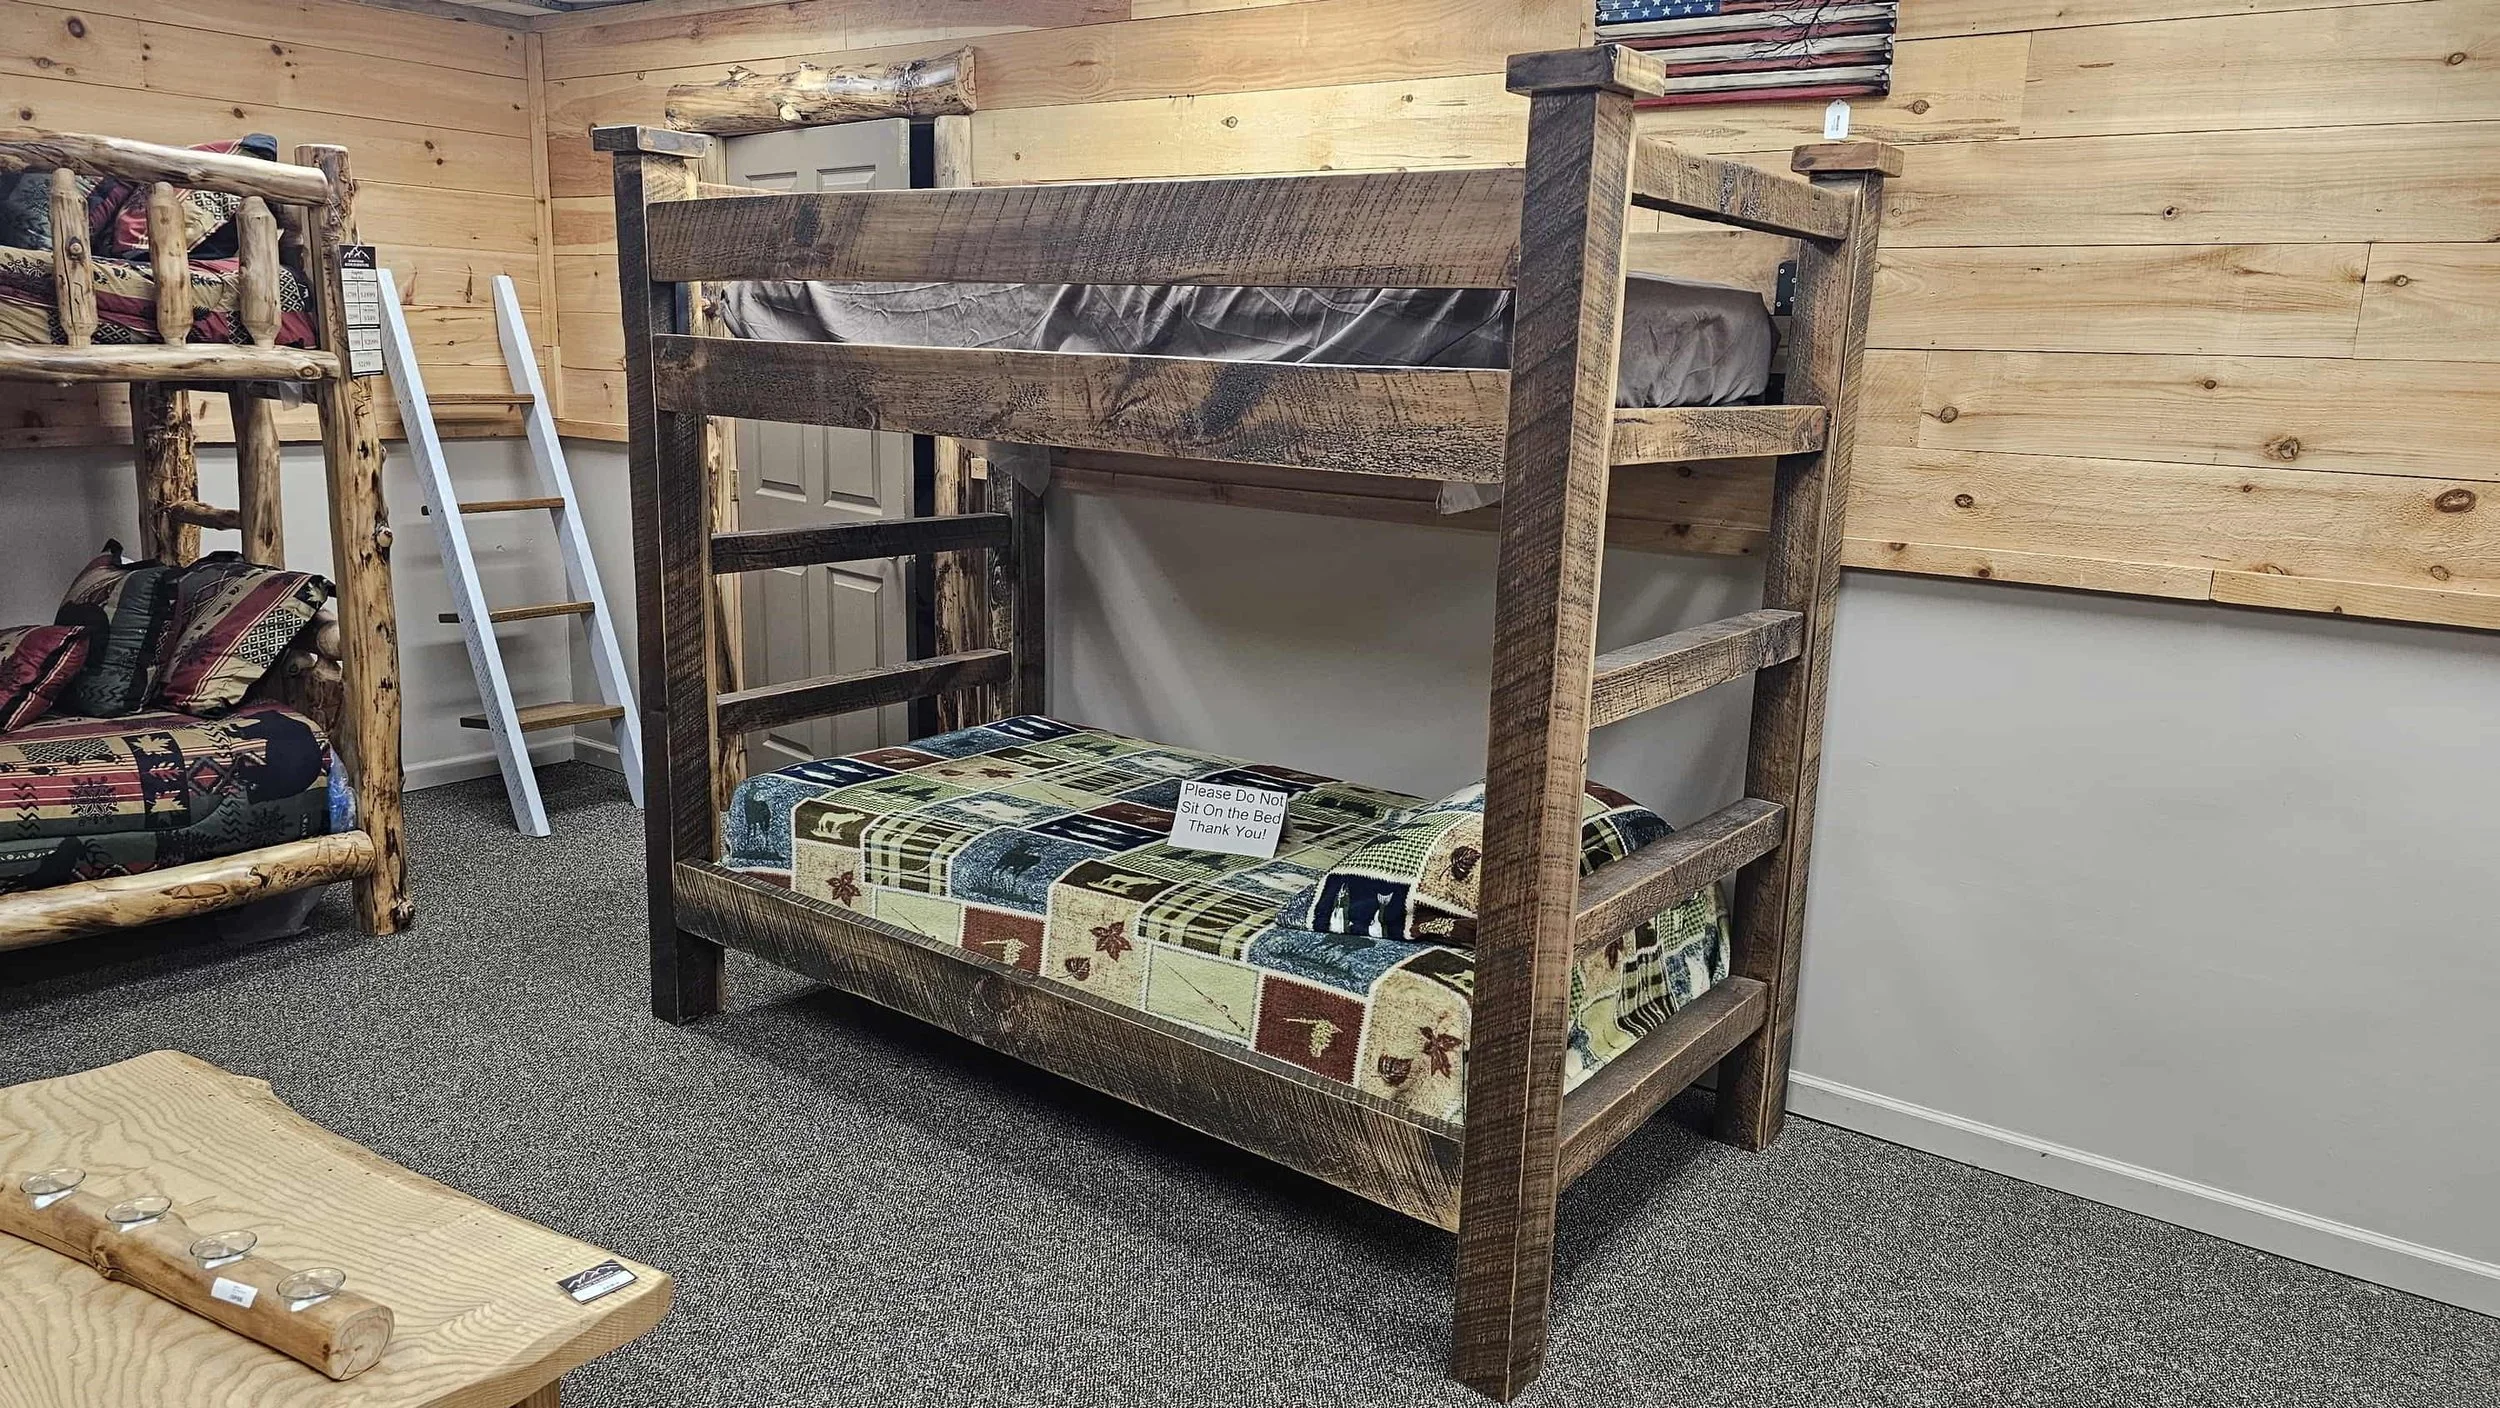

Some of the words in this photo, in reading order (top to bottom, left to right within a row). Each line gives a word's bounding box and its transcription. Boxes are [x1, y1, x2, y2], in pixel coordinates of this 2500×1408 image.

[1184, 783, 1232, 800] Please
[1235, 789, 1255, 804] Do
[1259, 792, 1284, 807] Not
[1180, 801, 1199, 815] Sit
[1203, 803, 1223, 818] On
[1227, 807, 1249, 820] the
[1253, 810, 1281, 824] Bed
[1188, 819, 1230, 836] Thank
[1235, 825, 1267, 840] You!
